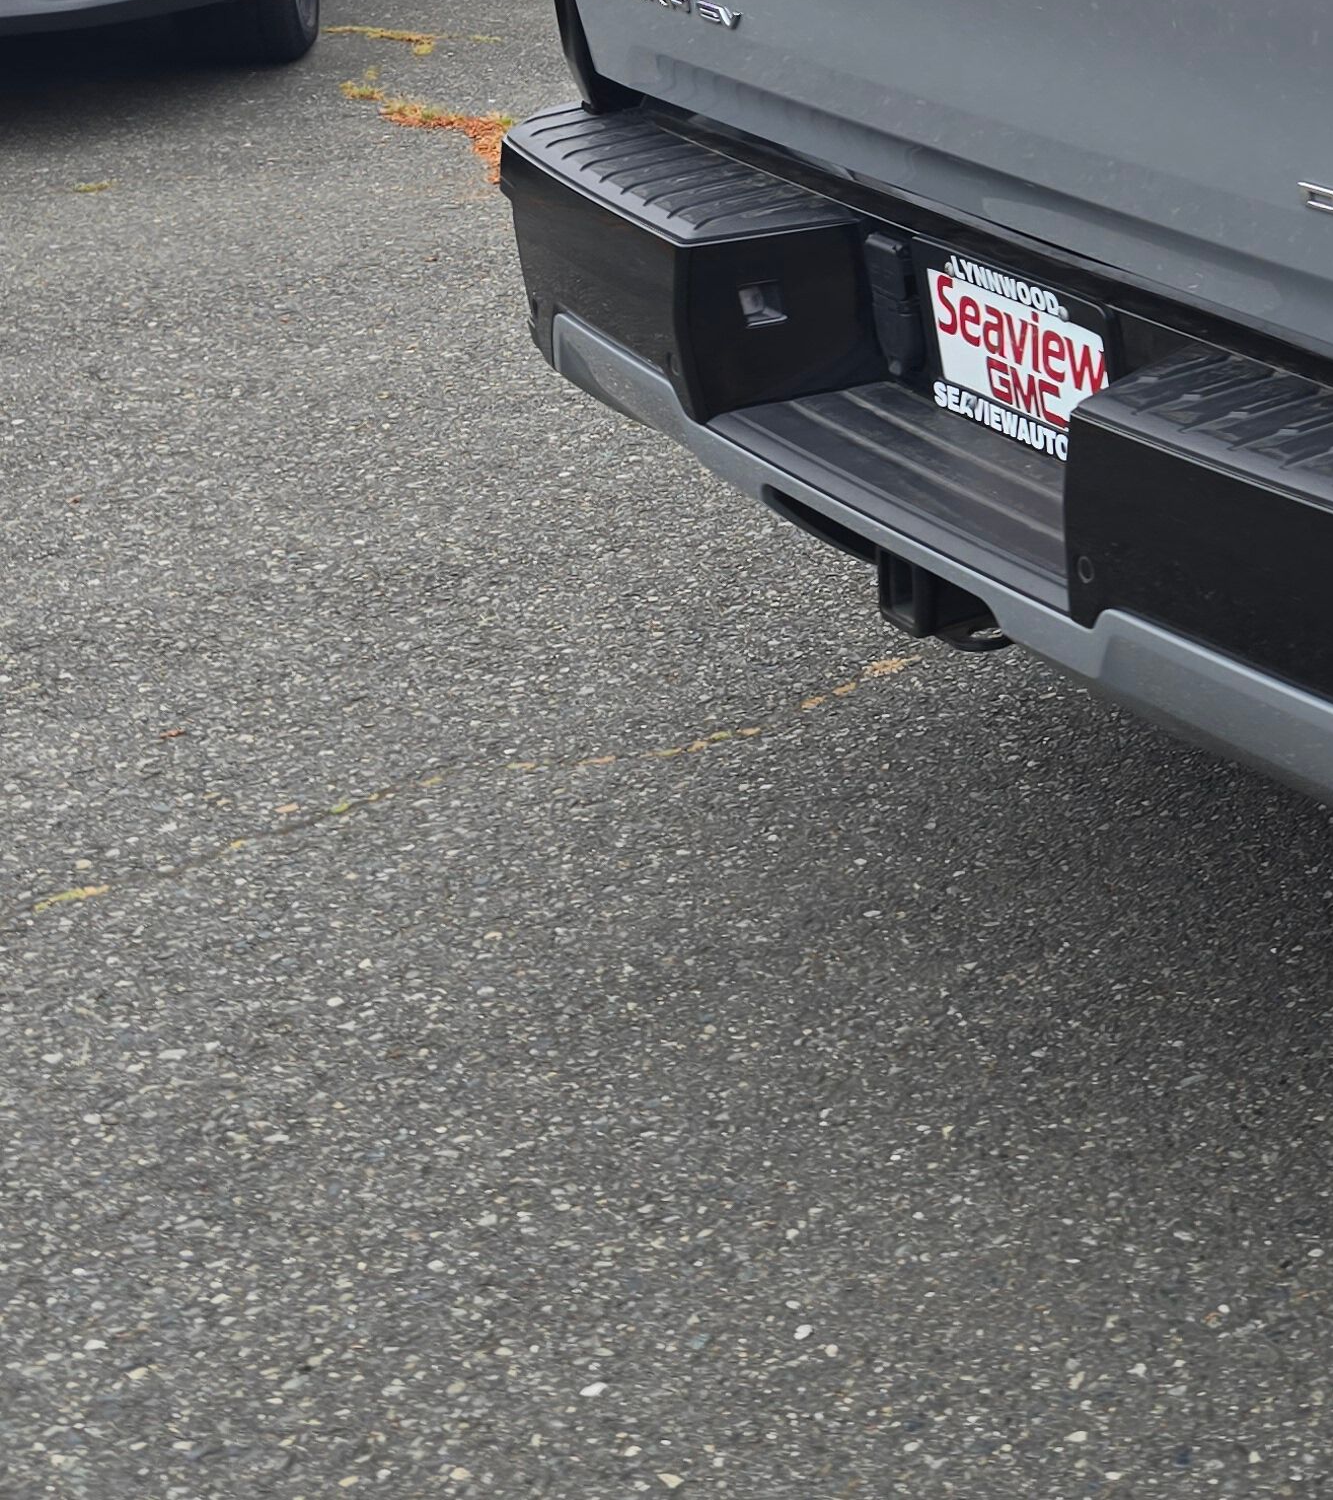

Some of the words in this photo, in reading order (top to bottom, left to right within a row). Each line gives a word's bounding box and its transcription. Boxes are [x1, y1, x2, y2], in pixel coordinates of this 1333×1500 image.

[697, 0, 743, 30] EV
[950, 255, 1061, 316] LYNNWOOD
[937, 274, 1107, 396] Seaview
[986, 356, 1070, 430] GMC
